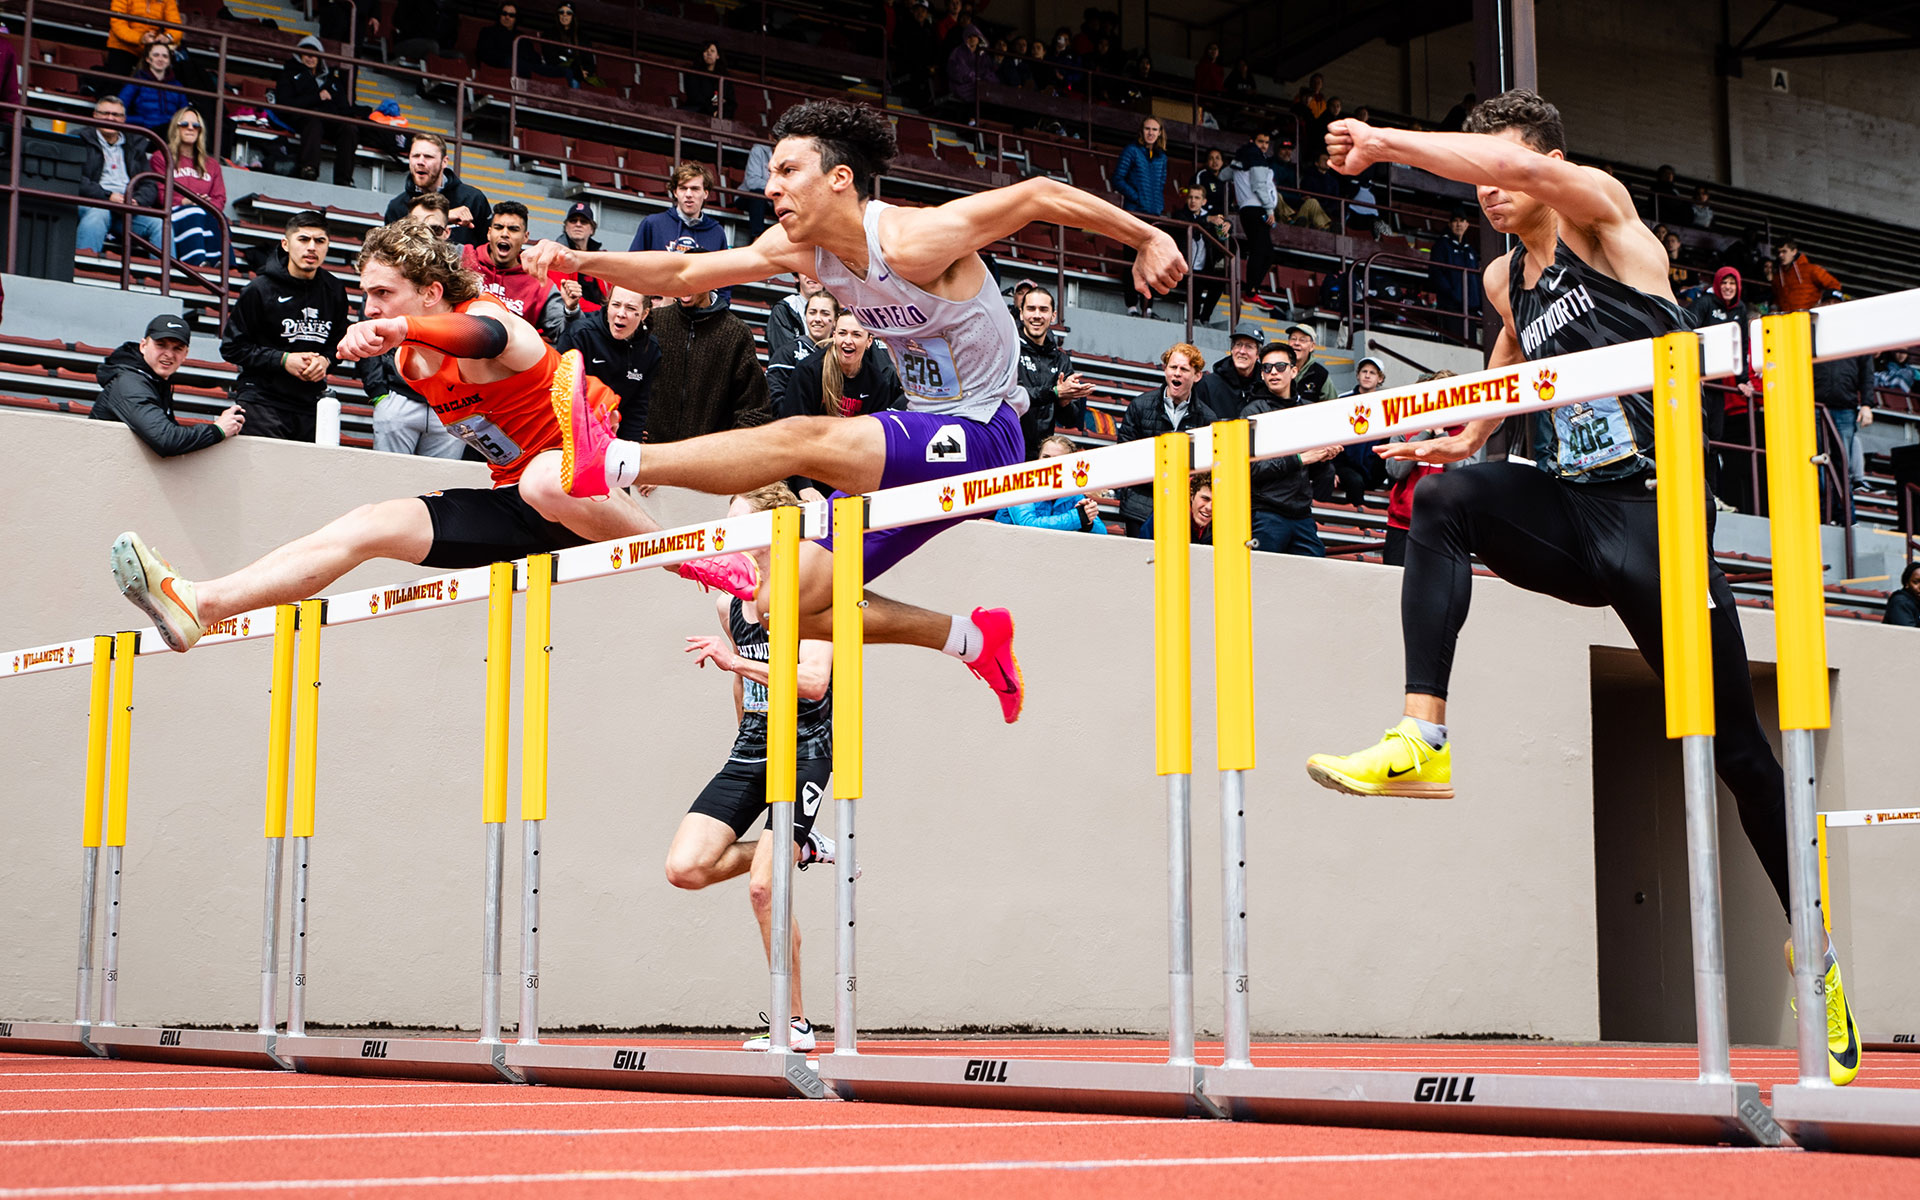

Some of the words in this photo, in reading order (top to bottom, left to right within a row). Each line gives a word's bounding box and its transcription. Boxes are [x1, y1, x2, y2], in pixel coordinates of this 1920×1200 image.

[1774, 71, 1787, 89] A
[281, 318, 333, 335] PIRATES
[1520, 284, 1595, 355] WHITWORTH
[903, 353, 943, 387] 278
[449, 392, 483, 411] CLARK
[1381, 373, 1520, 427] WILLAMETTE
[479, 433, 504, 458] 5
[1569, 416, 1615, 459] 402
[963, 463, 1063, 506] WILLAMETTE
[628, 528, 706, 564] WILLAMETTE
[383, 579, 444, 611] WILLAMETTE
[23, 647, 65, 670] WILLAMETTE
[295, 976, 306, 987] 30
[526, 977, 539, 989] 30
[159, 1030, 182, 1046] GILL
[361, 1040, 388, 1058] GILL
[1892, 1034, 1916, 1043] GILL
[613, 1050, 647, 1071] GILL
[964, 1059, 1008, 1083] GILL
[1413, 1076, 1476, 1102] GILL
